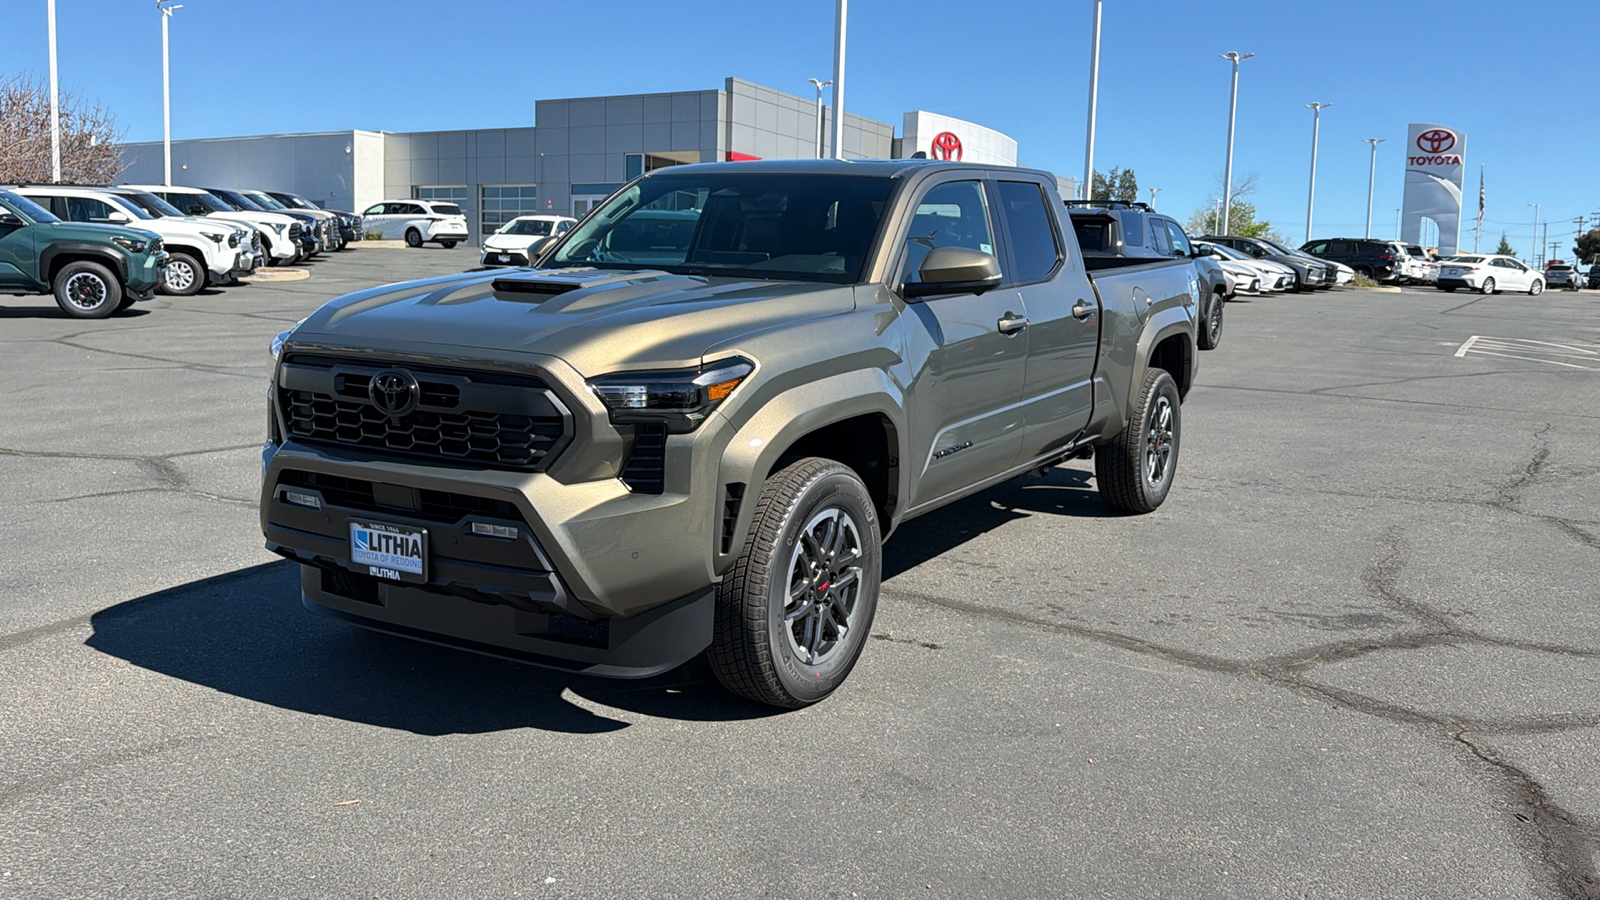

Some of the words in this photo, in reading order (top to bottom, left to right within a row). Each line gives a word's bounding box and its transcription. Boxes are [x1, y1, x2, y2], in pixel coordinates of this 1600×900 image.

[1408, 155, 1463, 166] TOYOTA
[369, 523, 386, 531] SINCE
[368, 531, 422, 559] LITHIA
[354, 549, 379, 561] TOYOTA
[380, 554, 390, 563] OF
[391, 556, 422, 569] REDDING
[376, 567, 401, 581] LITHIA
